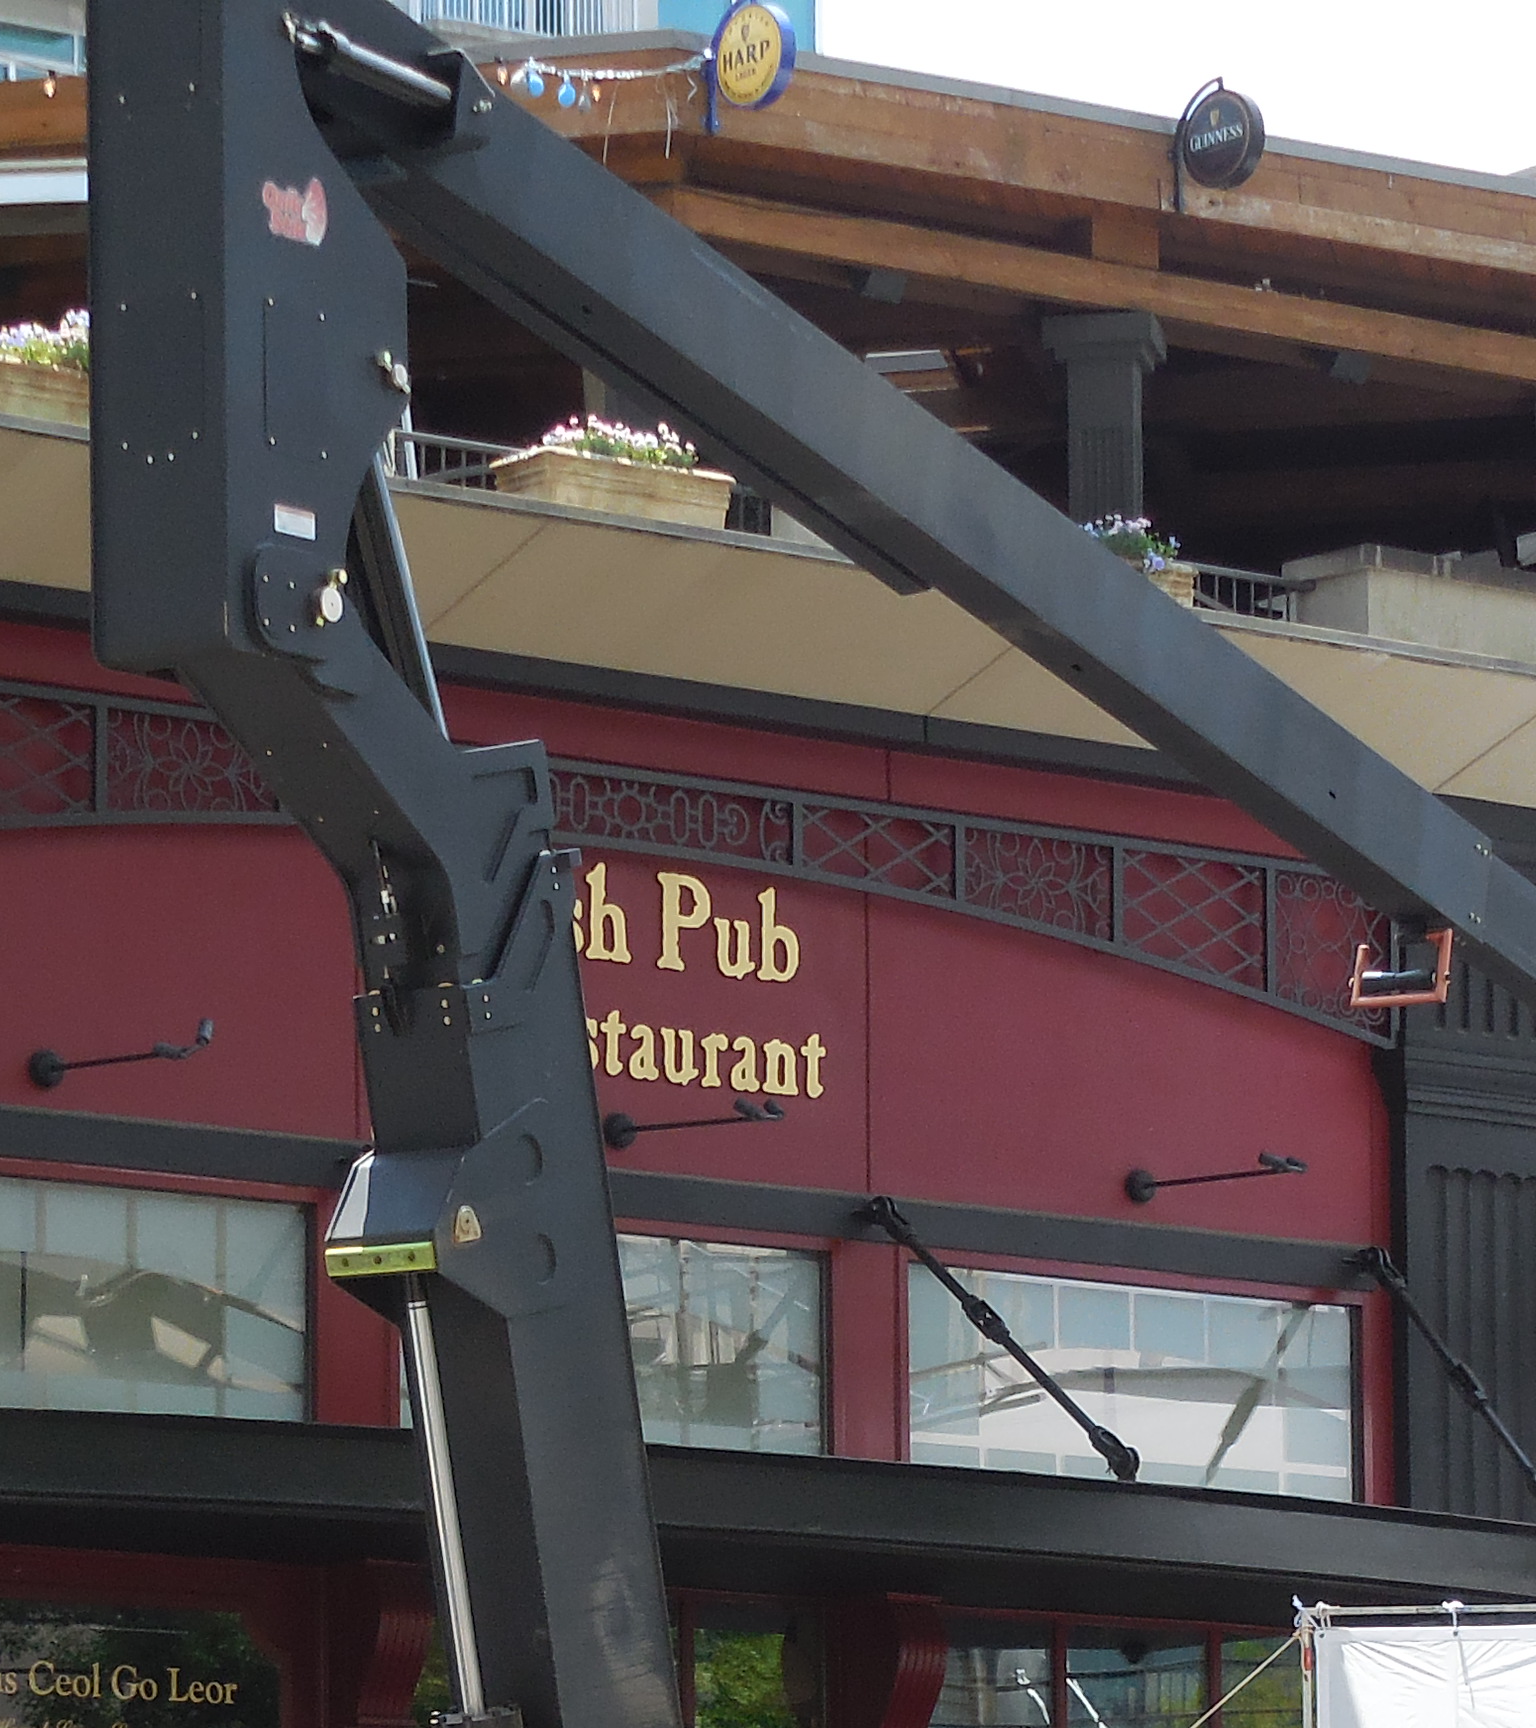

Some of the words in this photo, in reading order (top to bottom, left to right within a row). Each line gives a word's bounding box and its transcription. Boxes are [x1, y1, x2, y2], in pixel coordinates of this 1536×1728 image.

[722, 39, 771, 75] HARP
[1189, 123, 1244, 153] GUINNESS
[657, 871, 800, 983] Pub
[29, 1660, 102, 1699] Ceol
[111, 1664, 158, 1702] Go
[167, 1667, 237, 1705] Leor
